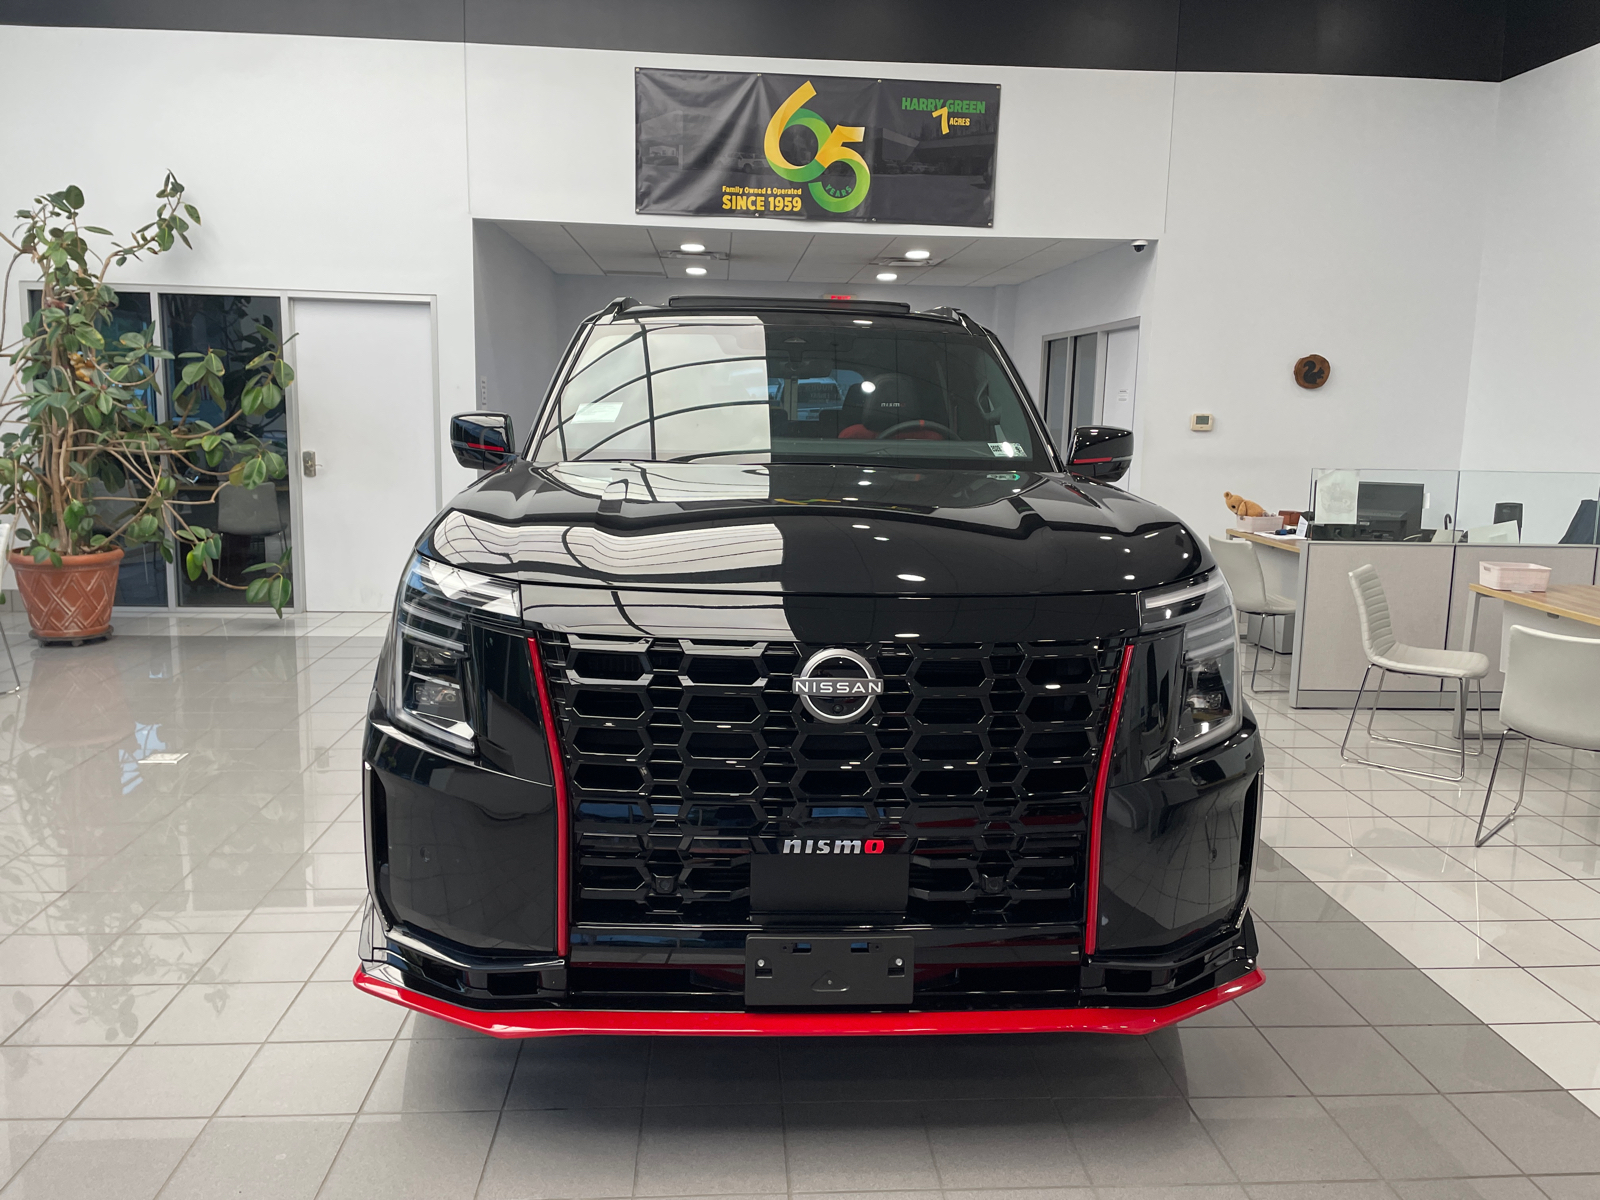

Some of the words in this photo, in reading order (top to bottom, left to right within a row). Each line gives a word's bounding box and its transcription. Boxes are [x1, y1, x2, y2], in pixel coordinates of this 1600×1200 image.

[901, 97, 944, 111] HARRY
[945, 99, 986, 114] GREEN
[931, 106, 950, 135] 7
[949, 117, 971, 126] ACRES
[764, 80, 870, 213] 65
[722, 185, 743, 194] Family
[744, 186, 766, 194] Owned
[772, 187, 802, 196] Operated
[825, 184, 853, 197] YEARS
[722, 194, 765, 211] SINCE
[768, 196, 802, 212] 1959
[795, 681, 882, 693] NISSAN
[782, 839, 885, 854] nismo
